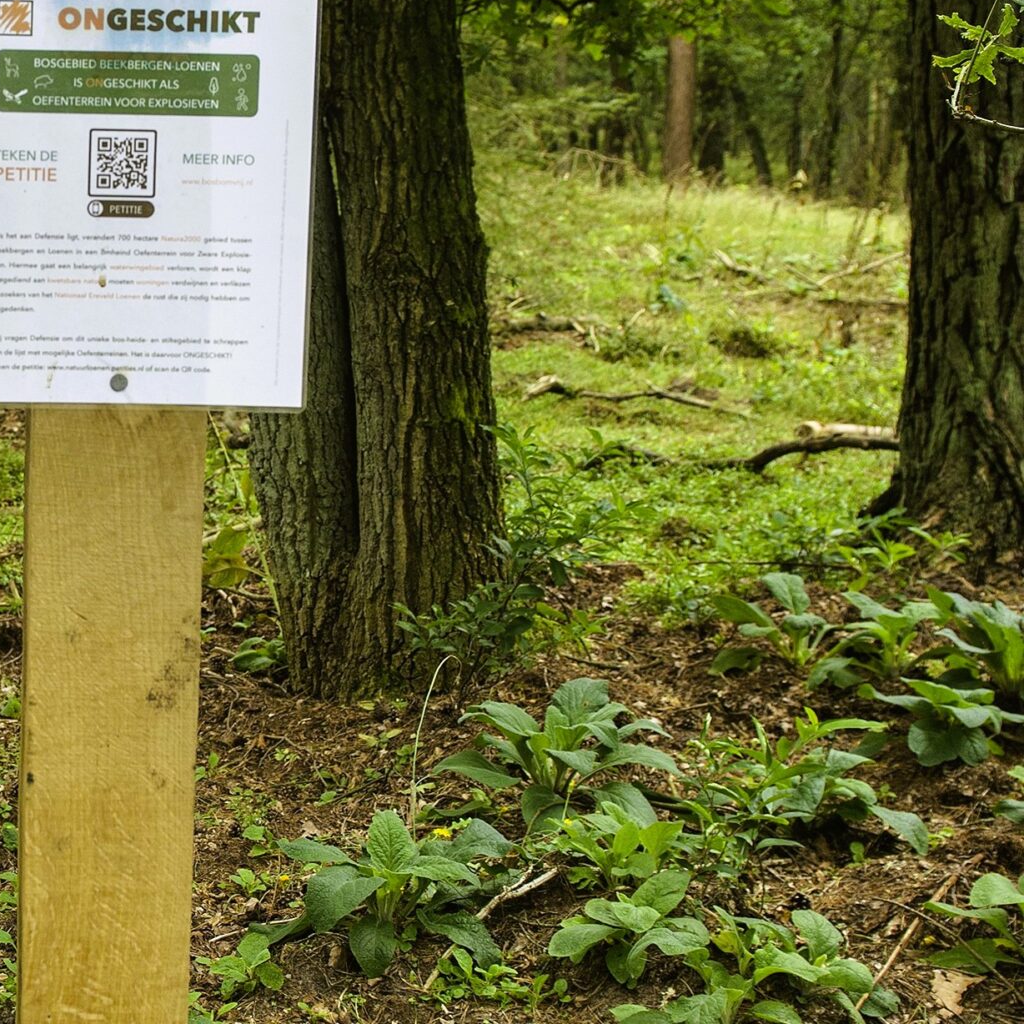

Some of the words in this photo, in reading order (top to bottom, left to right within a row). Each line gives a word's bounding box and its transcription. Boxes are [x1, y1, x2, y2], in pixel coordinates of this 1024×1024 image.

[58, 7, 261, 34] ONGESCHIKT
[34, 58, 96, 70] BOSGEBIED
[99, 60, 220, 72] BEEKBERGEN-LOENEN
[73, 77, 83, 88] IS
[85, 78, 156, 90] ONGESCHIKT
[159, 79, 180, 90] ALS
[32, 96, 112, 108] OEFENTERREIN
[114, 97, 145, 108] VOOR
[148, 98, 219, 110] EXPLOSIEVEN
[39, 150, 58, 162] DE
[182, 153, 218, 166] MEER
[222, 154, 255, 167] INFO
[109, 204, 143, 215] PETITIE
